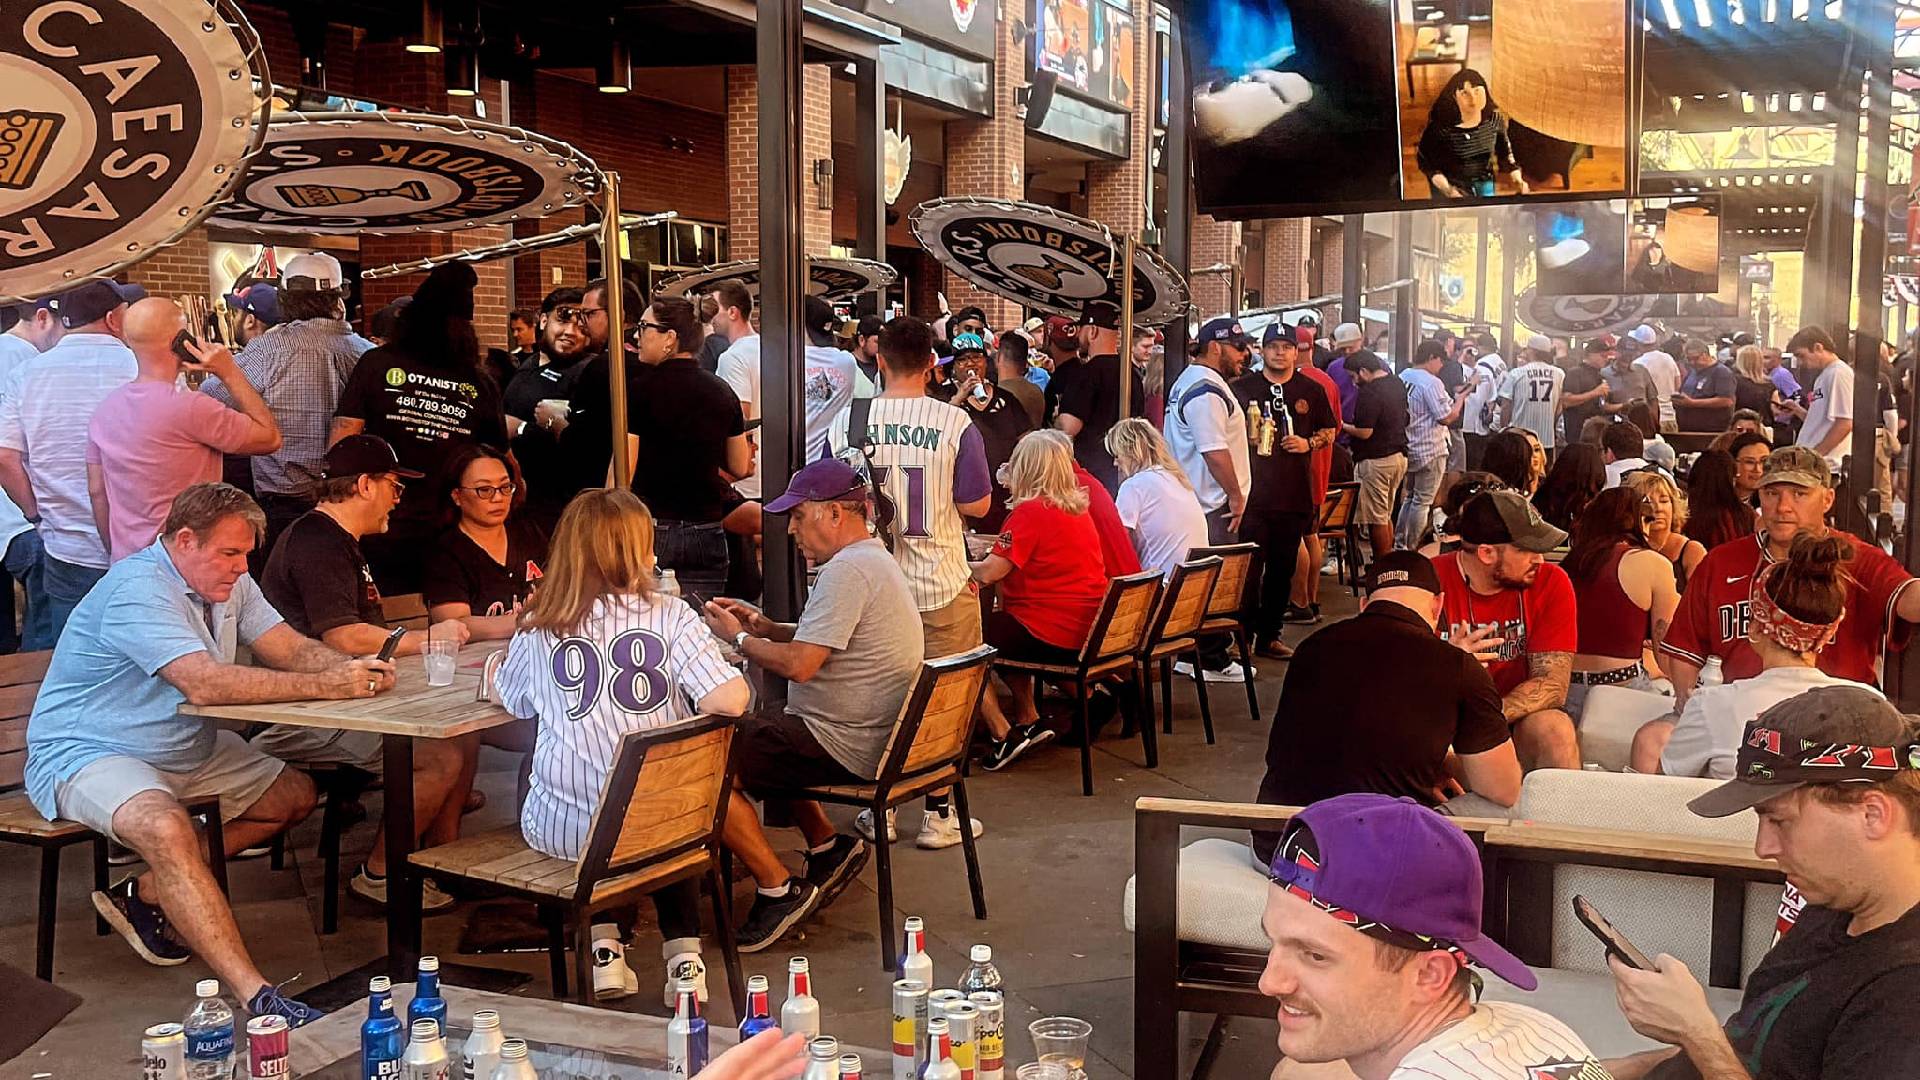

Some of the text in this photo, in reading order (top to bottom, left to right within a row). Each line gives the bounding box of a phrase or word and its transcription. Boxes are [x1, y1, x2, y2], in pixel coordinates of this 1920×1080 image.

[1527, 368, 1554, 379] GRACE
[1528, 380, 1554, 402] 17
[866, 423, 942, 452] HNSON
[549, 628, 671, 721] 98
[378, 1060, 401, 1075] BU
